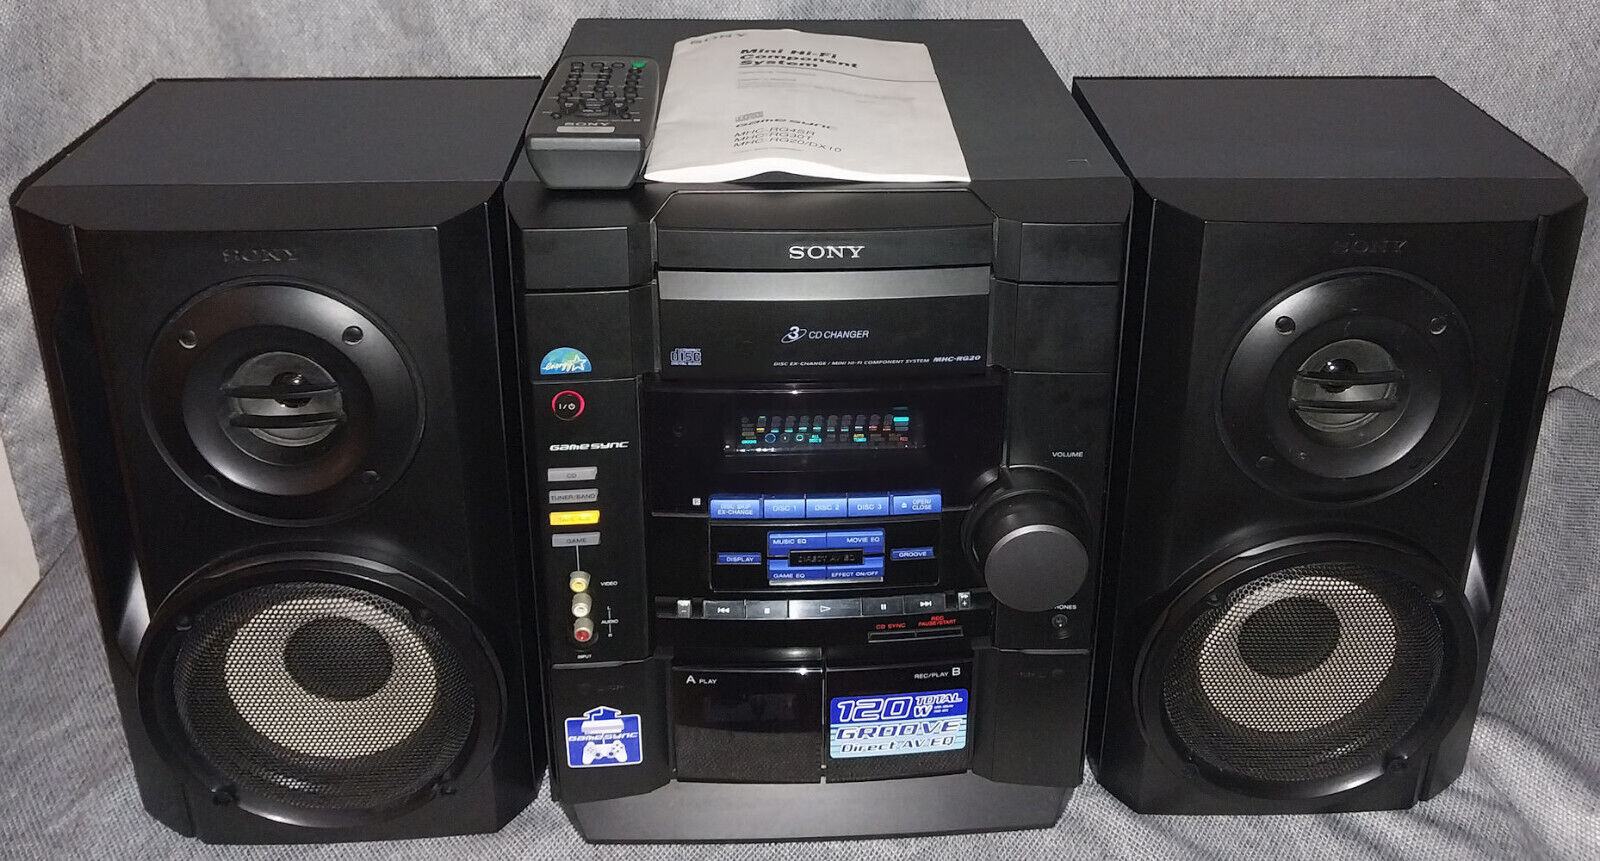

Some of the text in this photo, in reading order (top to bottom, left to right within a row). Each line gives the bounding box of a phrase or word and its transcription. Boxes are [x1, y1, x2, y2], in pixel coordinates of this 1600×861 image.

[690, 32, 746, 45] SONY
[739, 54, 859, 69] Component
[739, 59, 818, 68] System
[222, 248, 298, 263] SONY
[789, 245, 866, 260] SONY
[808, 331, 823, 340] CD
[824, 330, 870, 340] CHANGER
[864, 358, 905, 366] COMPONENT
[906, 357, 931, 365] SYSTEM
[934, 354, 982, 363] MHC-RG20
[686, 675, 696, 685] A
[914, 667, 961, 680] REC/PLAY B
[915, 692, 963, 706] TOTAL
[837, 696, 914, 722] 120
[913, 705, 932, 717] W
[836, 719, 963, 741] GROOVE
[841, 736, 955, 753] Direct AV EQ
